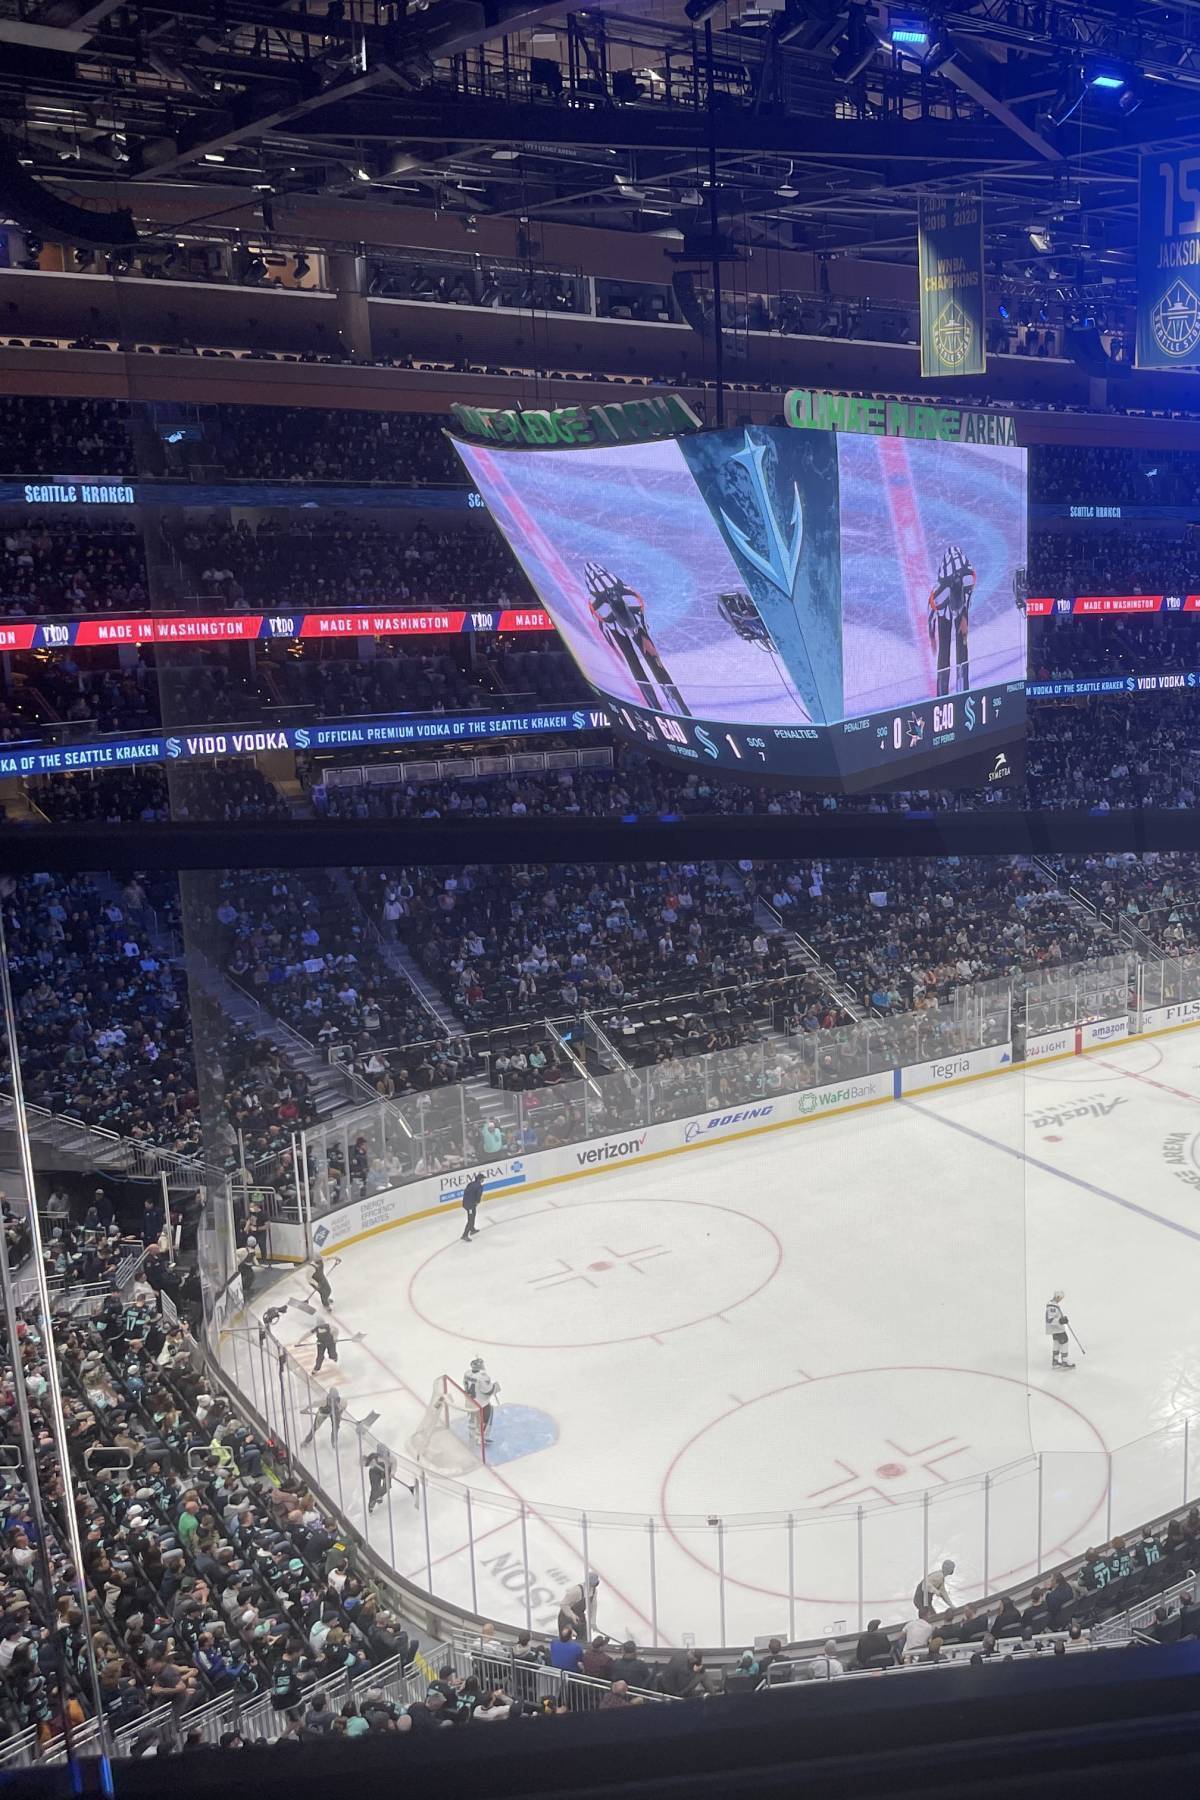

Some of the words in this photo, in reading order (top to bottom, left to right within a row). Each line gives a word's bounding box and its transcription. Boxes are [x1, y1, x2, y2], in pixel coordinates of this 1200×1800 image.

[953, 209, 978, 226] 2020
[937, 256, 966, 274] WNBA
[924, 271, 979, 292] CHAMPIONS
[787, 391, 885, 434] CLIMATE
[886, 402, 961, 440] PLEDGE
[961, 412, 1017, 446] ARENA
[25, 484, 77, 504] SEATTLE
[82, 485, 136, 504] KRAKEN
[1070, 506, 1094, 518] SEATTLE
[1083, 601, 1100, 609] MADE
[1103, 600, 1111, 608] IN
[1113, 599, 1154, 609] WASHINGTON
[269, 617, 294, 632] VIDO
[319, 619, 352, 631] MADE
[358, 619, 369, 630] IN
[374, 617, 449, 630] WASHINGTON
[471, 612, 493, 627] VIDO
[515, 614, 544, 627] MADE
[42, 624, 69, 642] VIDO
[98, 625, 132, 639] MADE
[138, 625, 152, 637] IN
[158, 622, 243, 636] WASHINGTON
[1033, 685, 1053, 695] VODKA
[1054, 685, 1062, 694] OF
[1064, 684, 1075, 693] THE
[1076, 682, 1101, 693] SEATTLE
[1101, 681, 1124, 691] KRAKEN
[1137, 678, 1156, 690] VIDO
[1159, 675, 1185, 688] VODKA
[933, 702, 954, 732] 6:40
[980, 695, 987, 725] 1
[318, 729, 364, 743] OFFICIAL
[367, 727, 414, 740] PREMIUM
[417, 723, 450, 737] VODKA
[453, 723, 465, 734] OF
[468, 721, 486, 733] THE
[489, 718, 529, 731] SEATTLE
[531, 716, 567, 728] KRAKEN
[774, 729, 819, 739] PENALTIES
[843, 719, 870, 733] PENALTIES
[877, 726, 888, 738] SOG
[893, 717, 902, 749] 0
[187, 735, 227, 755] VIDO
[232, 732, 289, 752] VODKA
[747, 737, 766, 748] SOG
[21, 756, 35, 769] OF
[39, 754, 62, 767] THE
[65, 749, 113, 765] SEATTLE
[116, 744, 159, 759] KRAKEN
[1091, 1022, 1125, 1038] amazon
[1041, 1040, 1066, 1054] LIGHT
[930, 1058, 970, 1079] Tegria
[819, 1089, 850, 1105] WaFd
[851, 1083, 876, 1099] Bank
[707, 1105, 773, 1129] BOEING
[1032, 1096, 1129, 1128] Alaska
[577, 1139, 640, 1165] verizon
[1163, 1132, 1191, 1165] ARENA
[277, 1675, 291, 1686] 55
